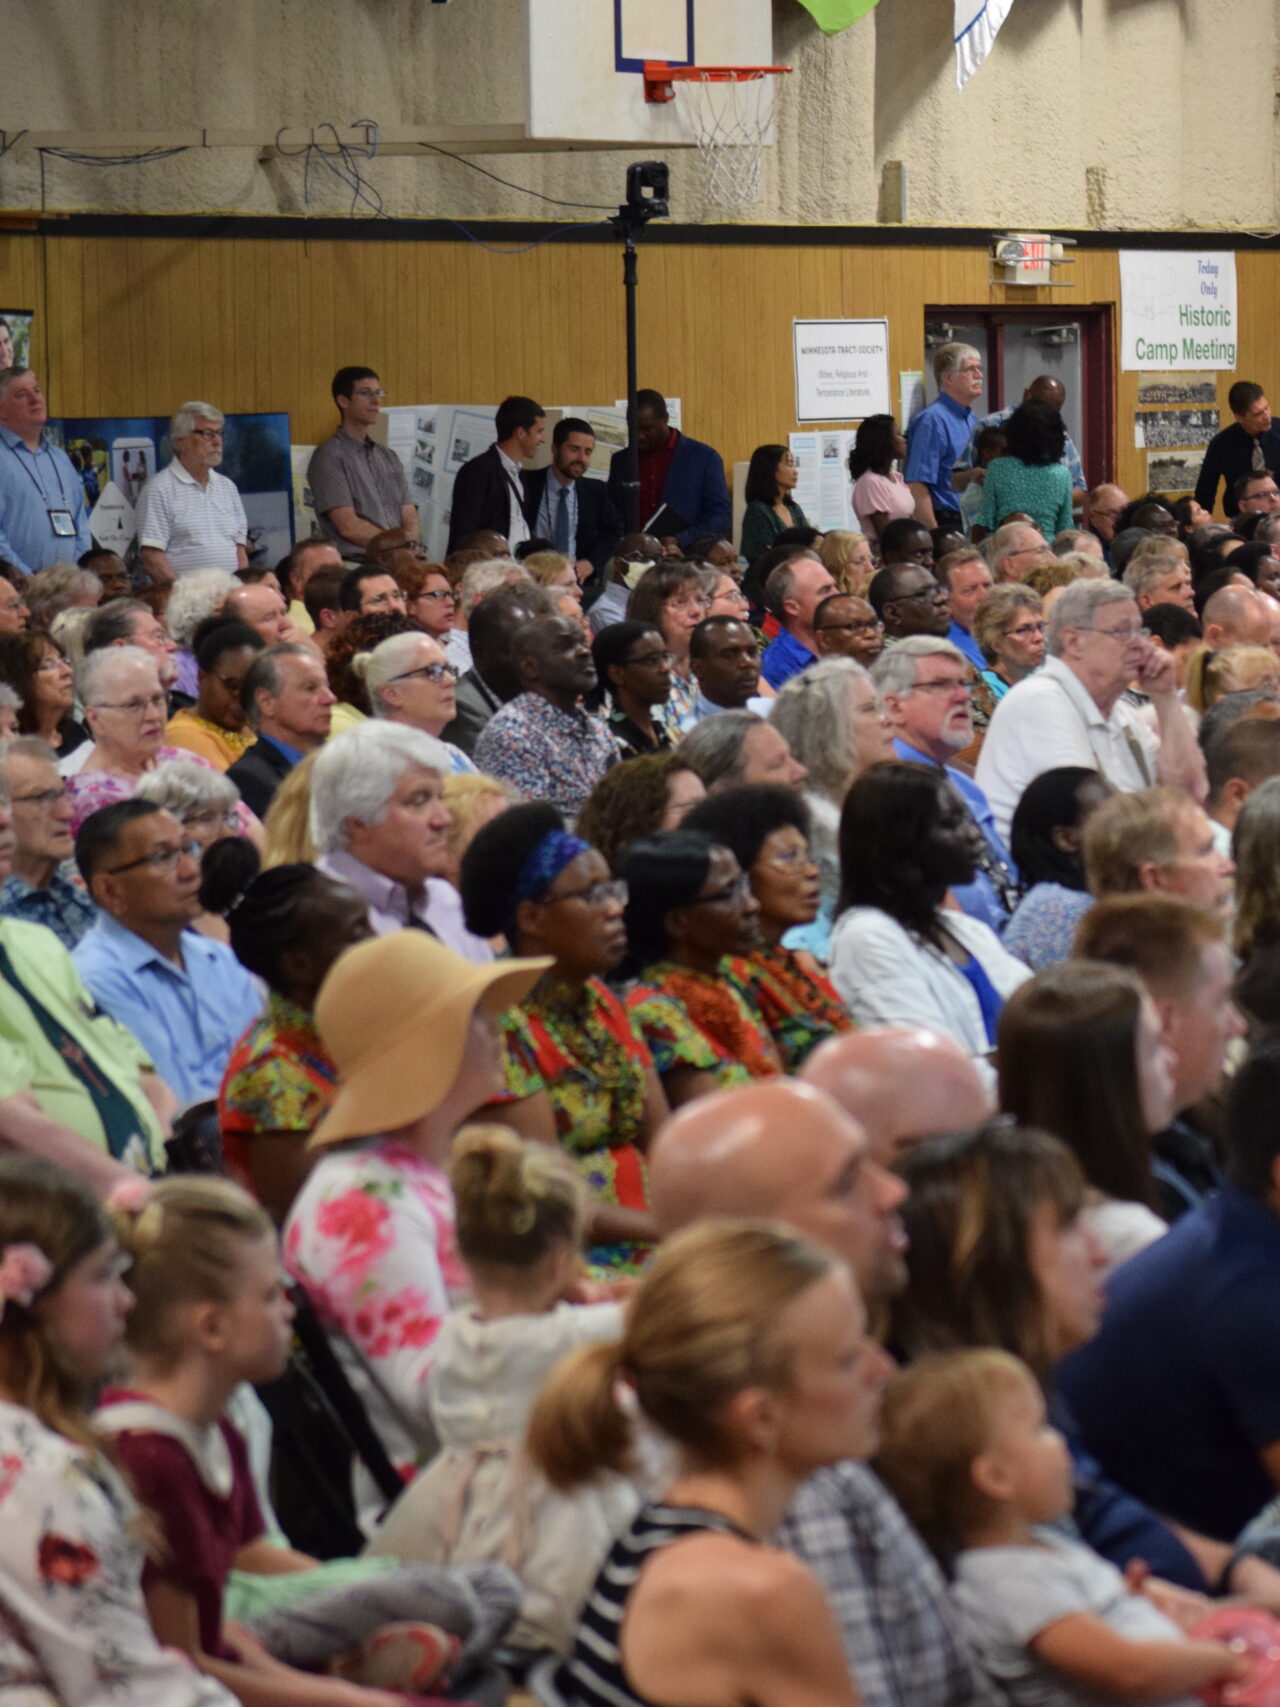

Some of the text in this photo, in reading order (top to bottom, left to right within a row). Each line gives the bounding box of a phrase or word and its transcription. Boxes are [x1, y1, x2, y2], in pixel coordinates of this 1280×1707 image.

[1197, 259, 1219, 278] Today
[1200, 281, 1218, 299] Only
[1179, 304, 1231, 327] Historic
[801, 345, 883, 355] MINNESOTA TRACT SOCIETY
[1135, 337, 1236, 365] Camp Meeting
